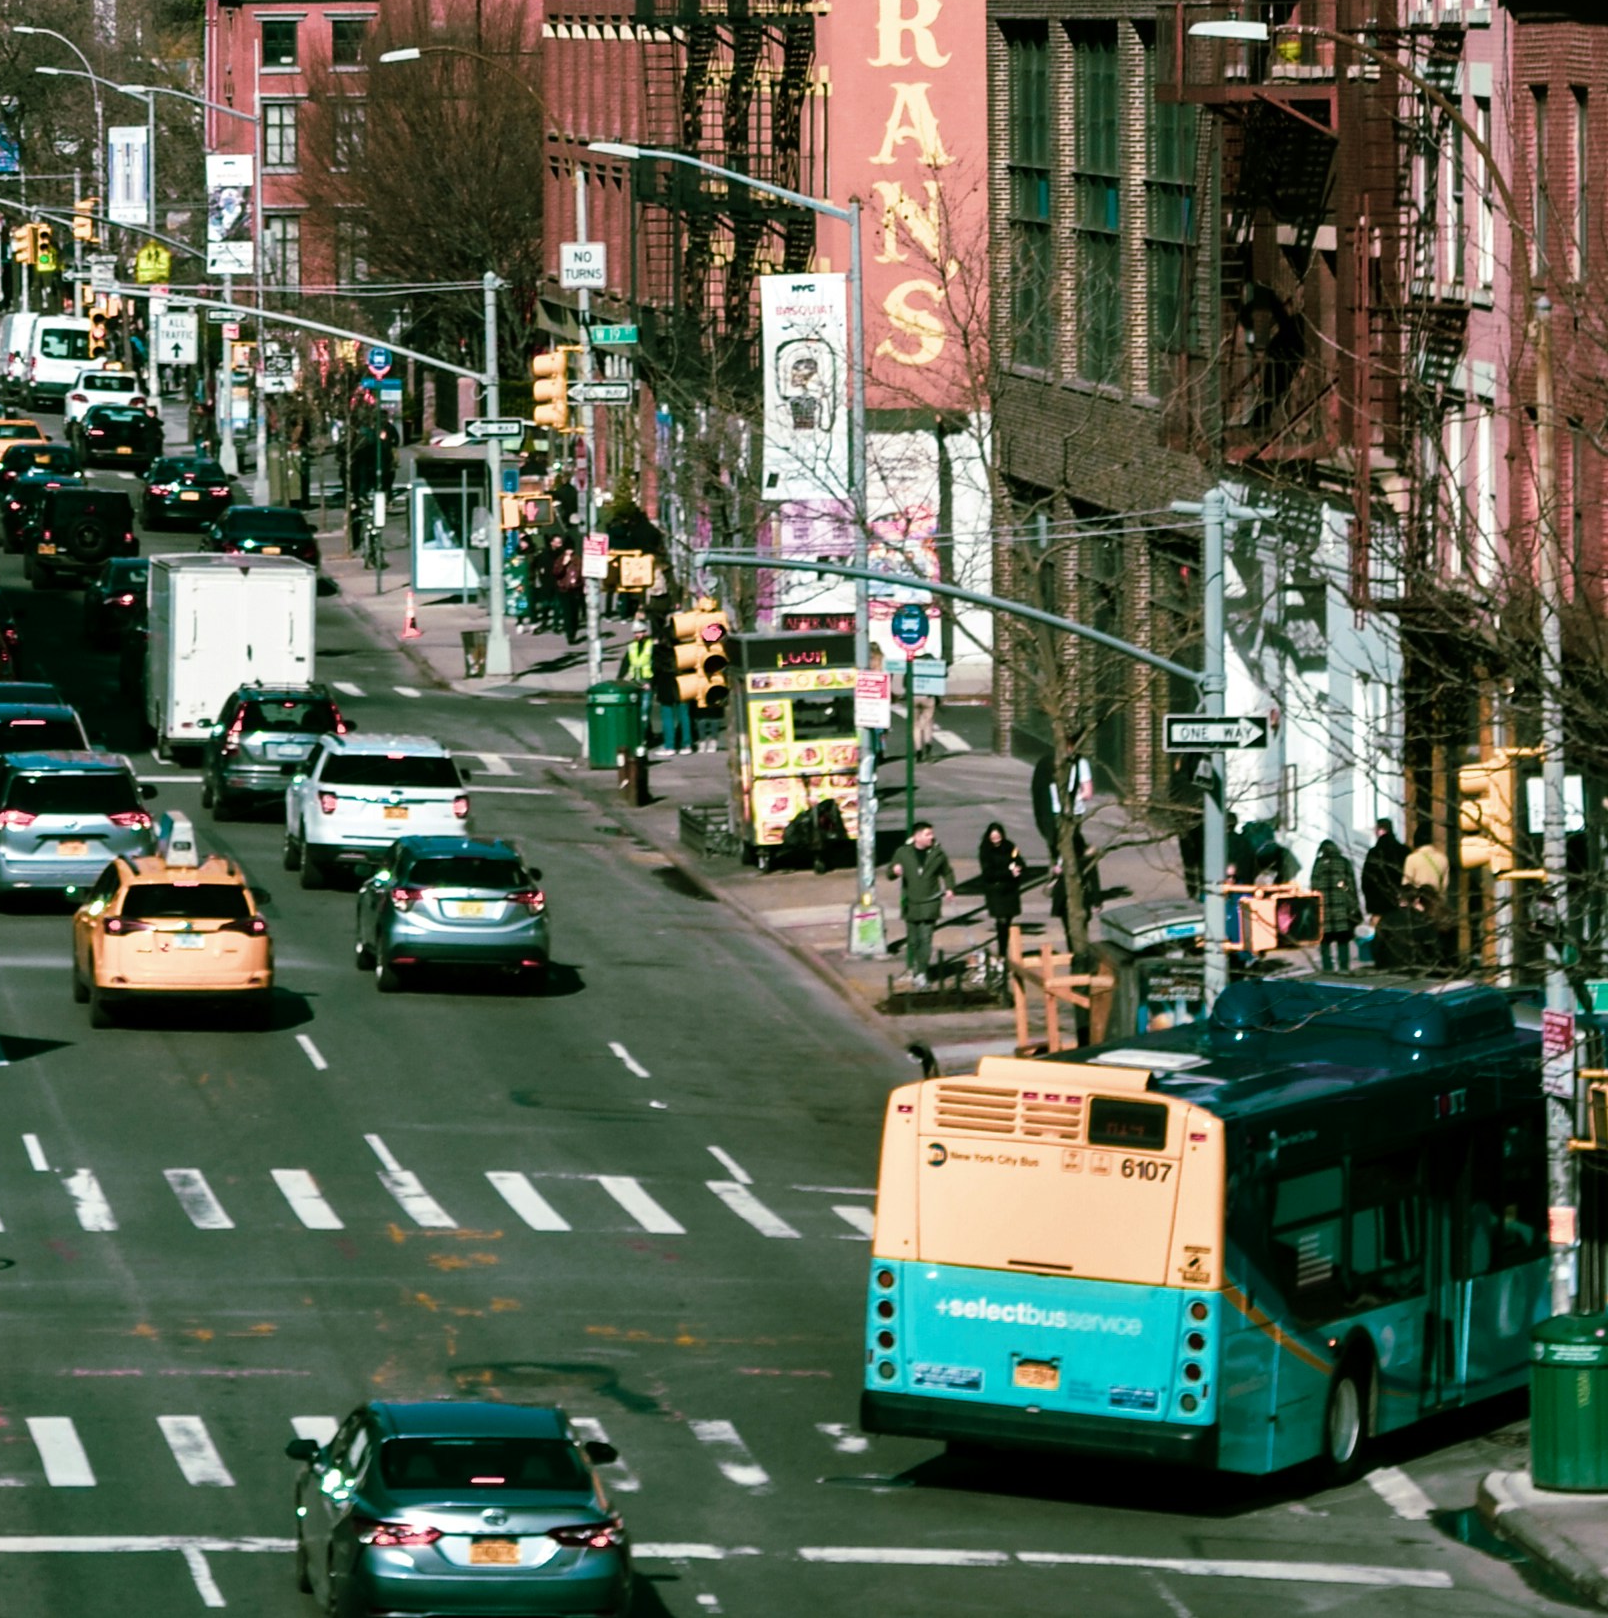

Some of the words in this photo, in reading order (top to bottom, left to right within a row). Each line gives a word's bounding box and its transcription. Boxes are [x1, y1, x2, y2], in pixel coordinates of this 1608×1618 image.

[573, 251, 592, 263] NO
[564, 268, 603, 280] TURNS
[168, 318, 186, 329] ALL
[161, 330, 193, 341] TRAFFIC
[595, 328, 606, 341] W
[609, 327, 621, 341] 19
[1180, 727, 1209, 741] ONE
[1223, 727, 1252, 740] WAY
[950, 1151, 971, 1161] New
[975, 1153, 994, 1163] York
[997, 1154, 1017, 1167] City
[1019, 1156, 1039, 1167] Bus
[1121, 1158, 1173, 1183] 6107
